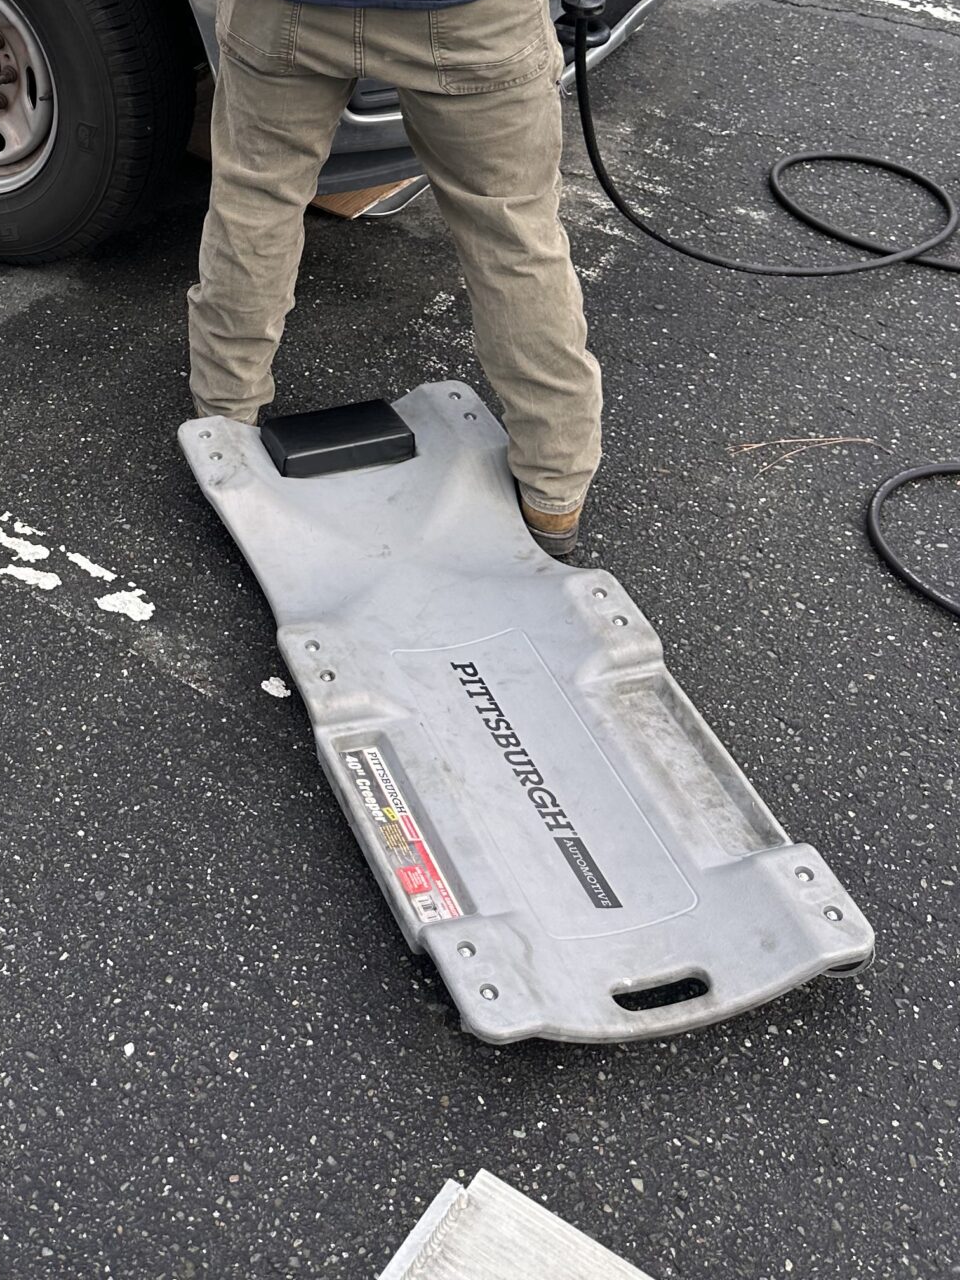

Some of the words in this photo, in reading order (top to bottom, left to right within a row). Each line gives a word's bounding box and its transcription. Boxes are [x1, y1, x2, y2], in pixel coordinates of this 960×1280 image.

[450, 661, 576, 834] PITTSBURGH
[356, 779, 388, 823] Creeper
[367, 751, 407, 814] PITTSBURGH
[562, 837, 613, 907] AUTOMOTIVE
